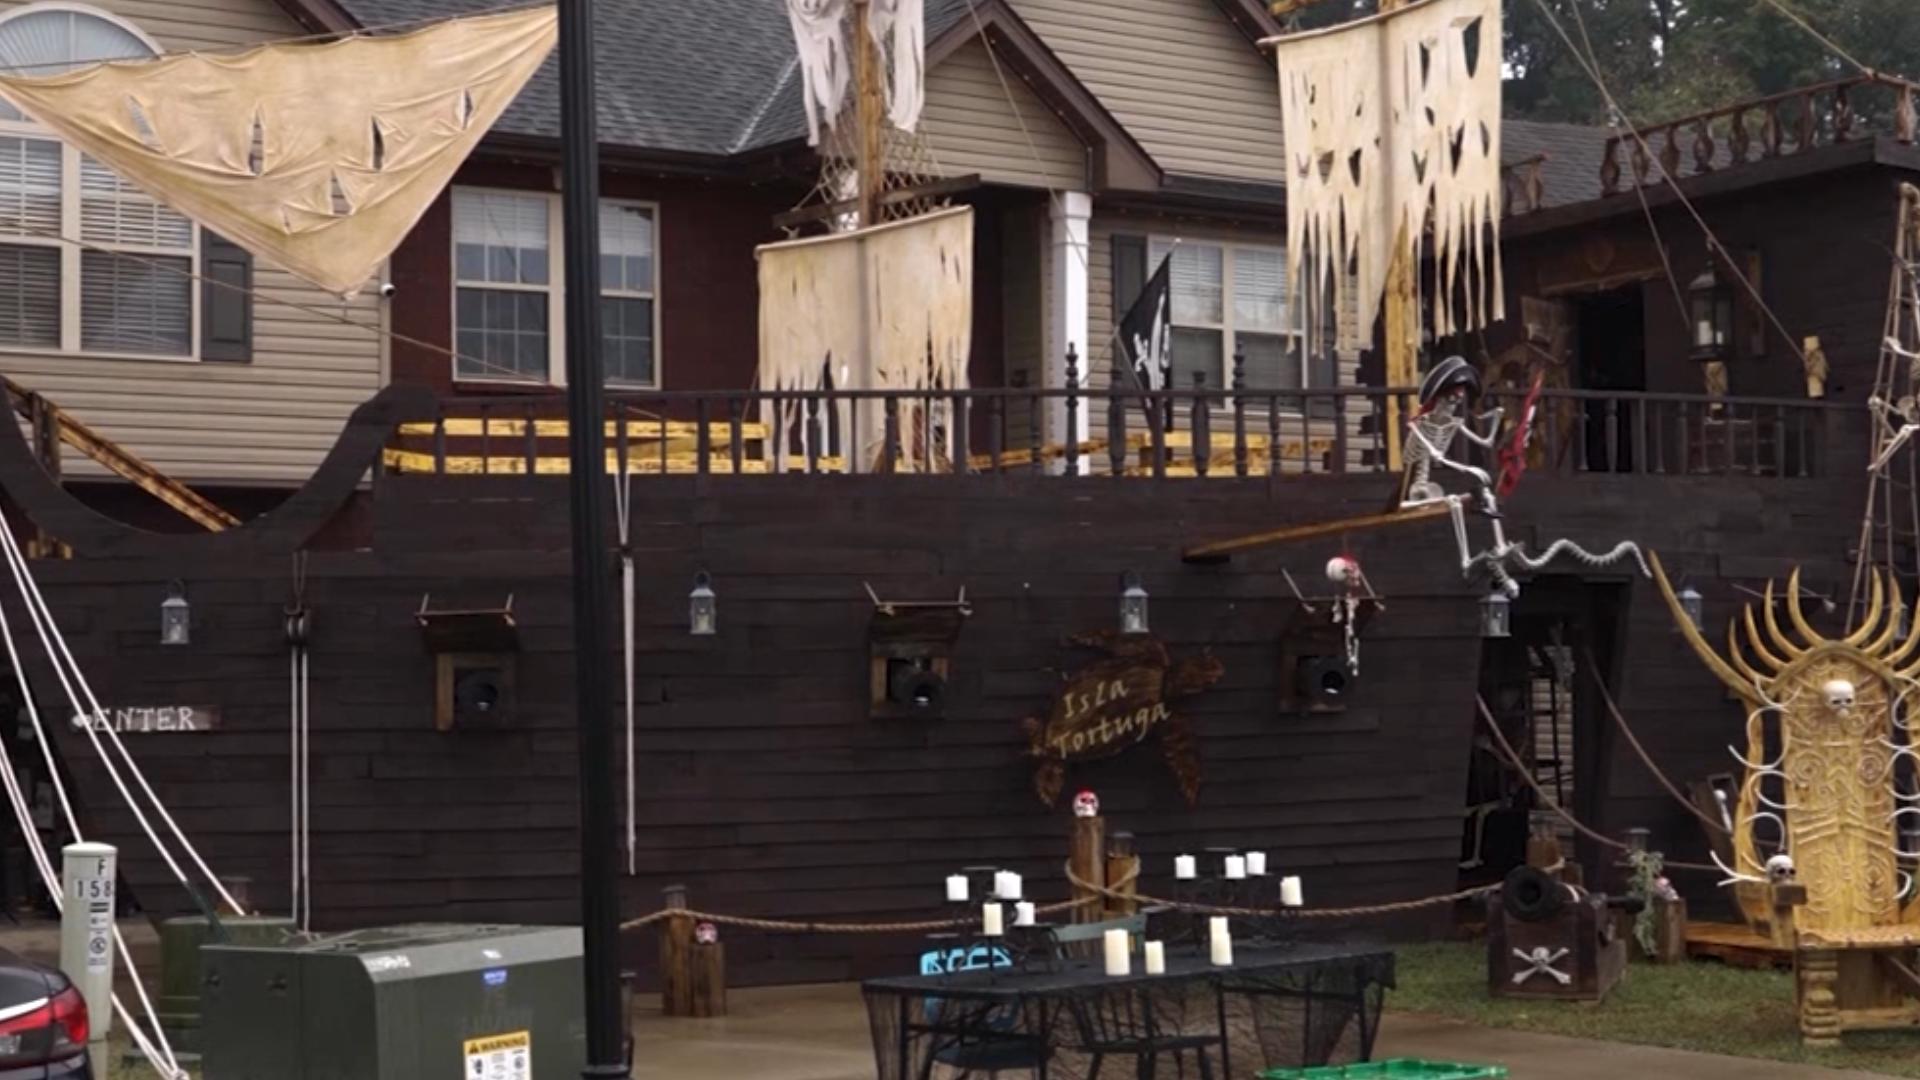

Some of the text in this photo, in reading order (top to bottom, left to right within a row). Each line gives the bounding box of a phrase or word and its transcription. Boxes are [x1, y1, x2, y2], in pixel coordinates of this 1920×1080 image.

[93, 706, 195, 732] ENTER
[1052, 702, 1172, 759] Tortuga
[98, 858, 106, 876] F
